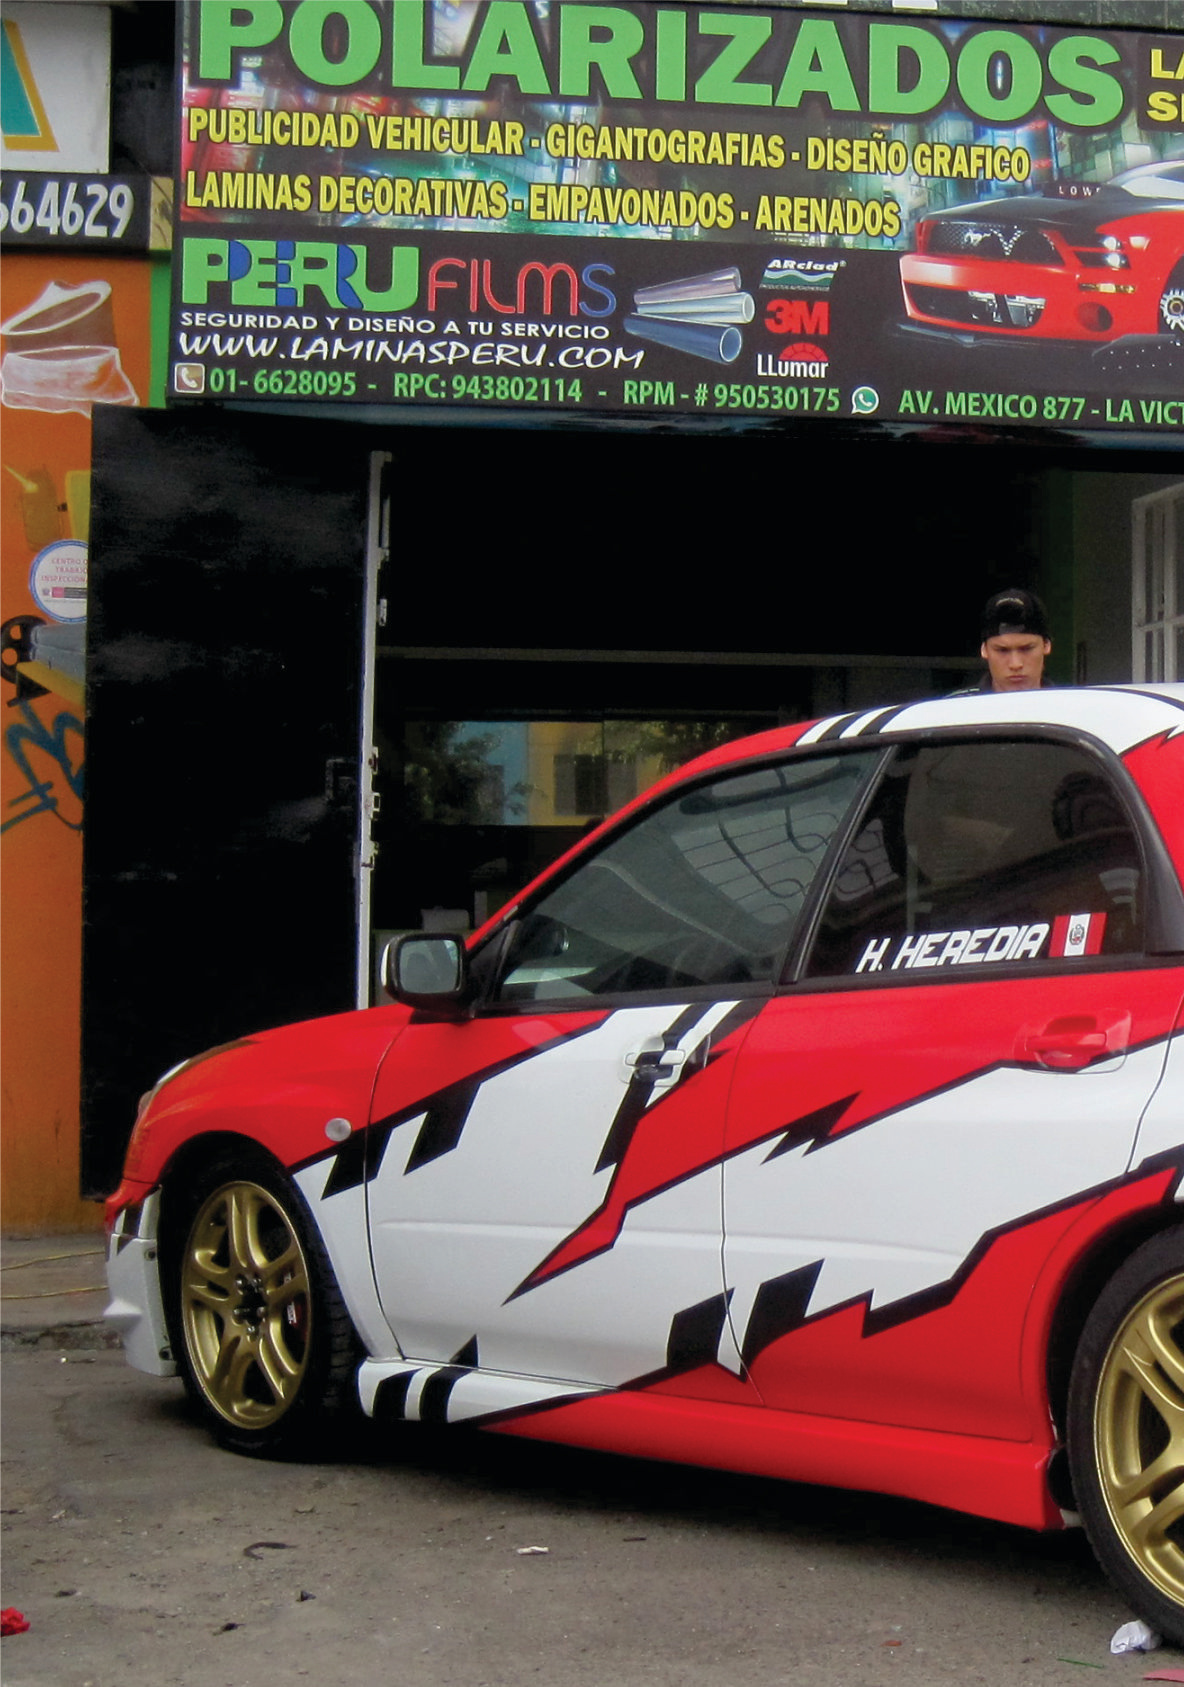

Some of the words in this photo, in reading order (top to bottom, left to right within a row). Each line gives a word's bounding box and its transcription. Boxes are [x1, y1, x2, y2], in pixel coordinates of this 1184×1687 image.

[198, 0, 1124, 127] POLARIZADOS
[188, 108, 360, 148] PUBLICIDAD
[367, 115, 524, 156] VEHICULAR
[546, 123, 785, 168] GIGANTOGRAFIAS
[807, 132, 908, 175] DISEÑO
[912, 143, 1030, 182] GRAFICO
[186, 171, 312, 211] LAMINAS
[319, 175, 507, 219] DECORATIVAS
[530, 184, 735, 229] EMPAVONADOS
[755, 195, 901, 238] ARENADOS
[182, 237, 420, 313] PERU
[180, 312, 318, 330] SEGURIDAD
[326, 317, 341, 331] Y
[348, 316, 436, 334] DISEÑO
[443, 320, 461, 335] A
[468, 320, 493, 336] TU
[501, 322, 610, 339] SERVICIO
[764, 298, 830, 335] 3M
[179, 332, 645, 370] WWW.LAMINASPERU.COM
[757, 353, 830, 379] LLumar
[623, 380, 675, 406] RPM
[899, 389, 939, 414] AV.
[944, 391, 1037, 419] MEXICO
[1043, 396, 1086, 421] 877
[1105, 398, 1135, 423] LA
[891, 923, 1050, 970] HEREDIA
